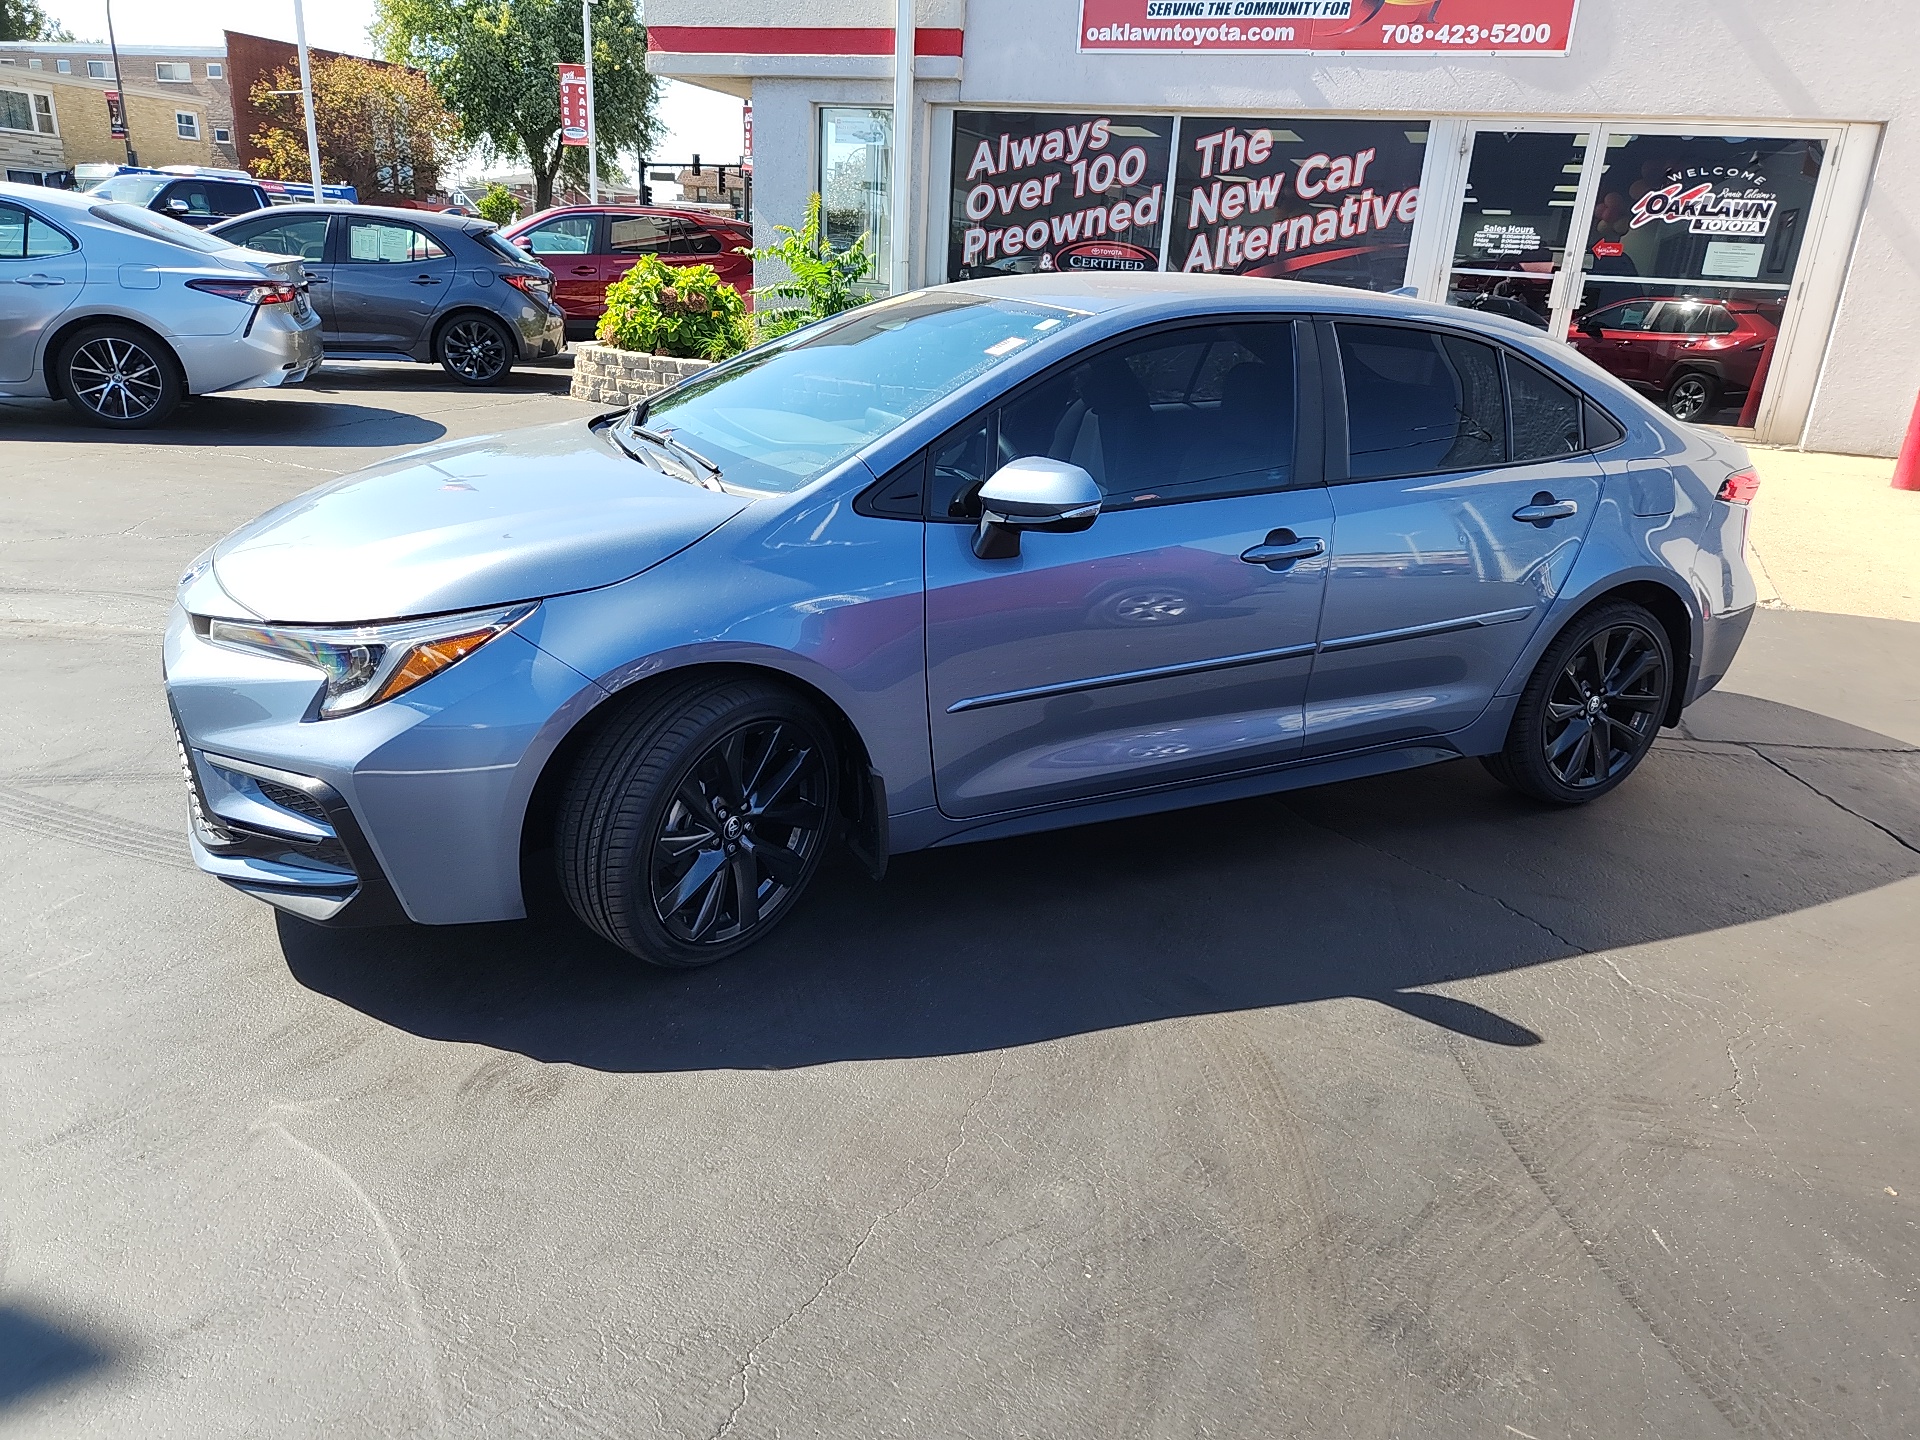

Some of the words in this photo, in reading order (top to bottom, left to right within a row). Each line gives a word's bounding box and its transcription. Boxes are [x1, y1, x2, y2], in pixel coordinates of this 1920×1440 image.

[1148, 1, 1205, 17] SERVING
[1207, 1, 1237, 17] THE
[1237, 1, 1321, 17] COMMUNITY
[1322, 1, 1351, 17] FOR
[1086, 22, 1295, 46] oaklawntoyota.com
[562, 85, 571, 126] USED
[577, 86, 586, 128] CARS
[966, 117, 1112, 182] Always
[1195, 126, 1274, 179] The
[965, 172, 1062, 222] Over
[1071, 145, 1148, 199] 100
[1667, 166, 1767, 186] WELCOME
[1187, 172, 1286, 230] New
[1295, 147, 1376, 201] Car
[962, 183, 1163, 266] Preowned
[1182, 186, 1420, 273] Alternative
[1508, 225, 1534, 233] Hours
[1701, 220, 1761, 233] TOYOTA
[1040, 252, 1054, 270] &
[1069, 255, 1145, 271] CERTIFIED
[1100, 248, 1123, 256] TOYOTA
